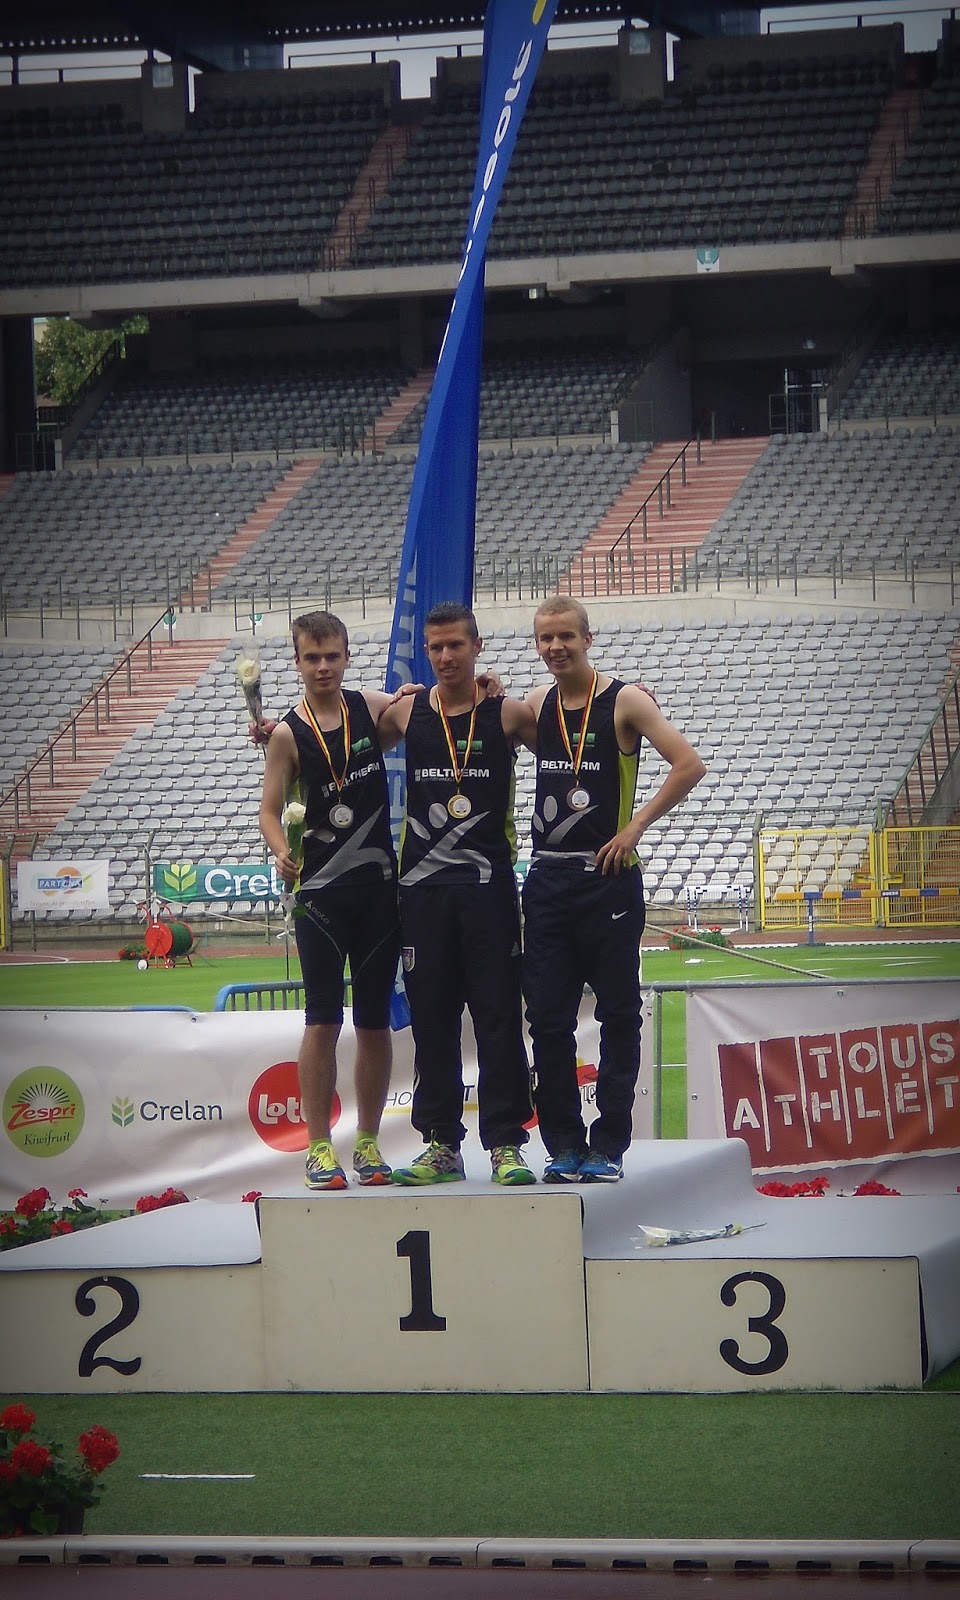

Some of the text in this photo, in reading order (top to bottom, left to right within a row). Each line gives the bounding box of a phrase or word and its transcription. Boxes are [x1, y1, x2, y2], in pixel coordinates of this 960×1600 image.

[328, 761, 381, 792] BLTHERM
[541, 760, 601, 771] BELTHRM
[204, 867, 286, 898] Crel
[809, 1032, 955, 1079] TOUS
[7, 1103, 76, 1131] Zespri
[140, 1100, 223, 1121] Crelan
[24, 1130, 71, 1147] Kiwifruit
[397, 1231, 446, 1331] 1
[75, 1276, 141, 1378] 2
[720, 1272, 788, 1375] 3
